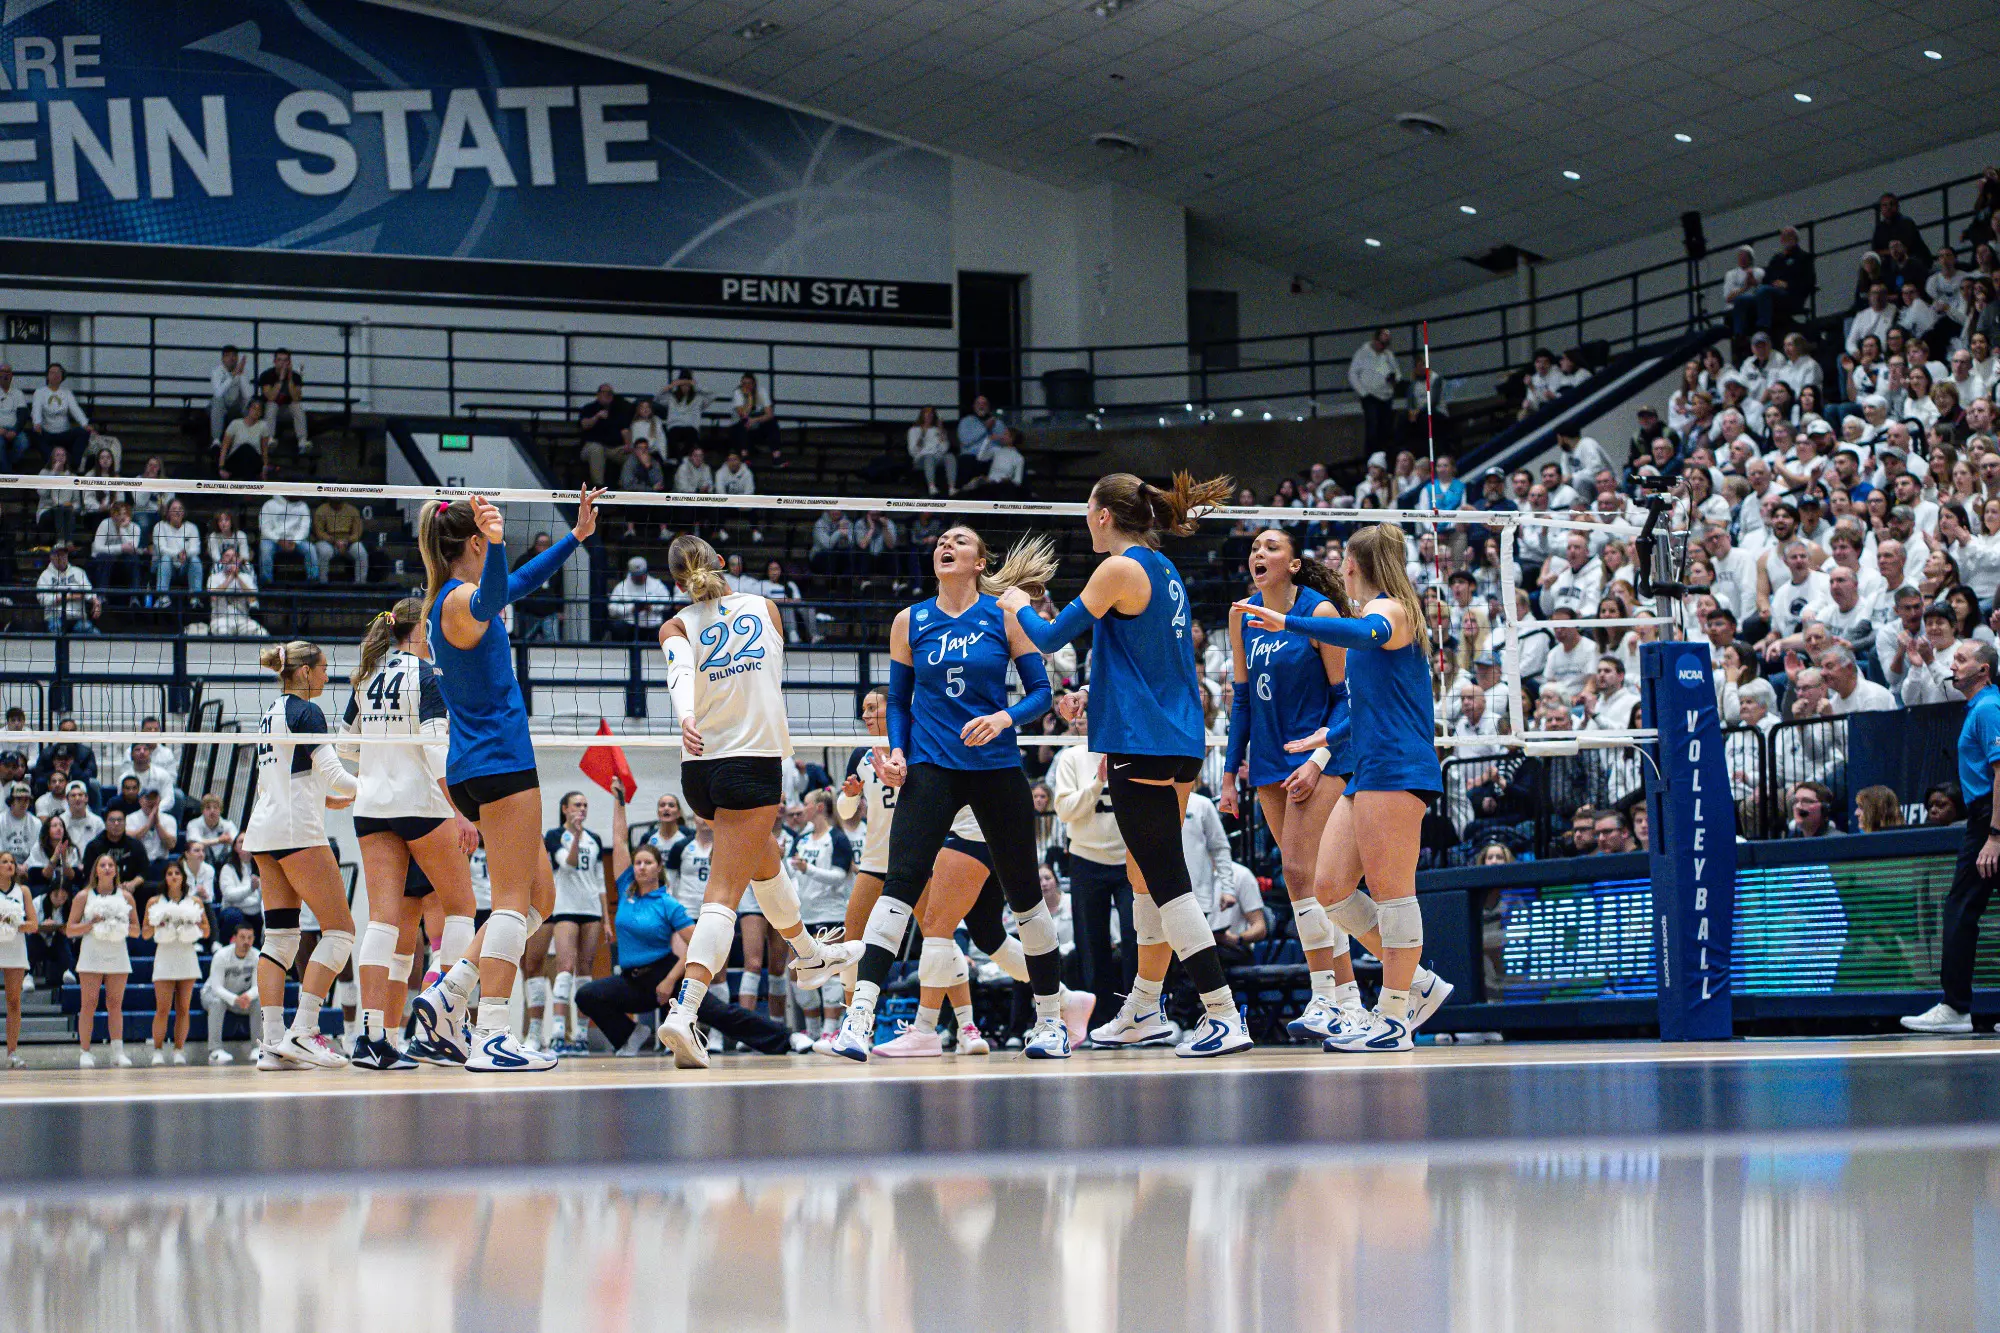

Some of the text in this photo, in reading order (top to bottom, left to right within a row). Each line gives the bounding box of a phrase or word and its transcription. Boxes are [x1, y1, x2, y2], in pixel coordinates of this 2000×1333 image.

[0, 35, 106, 90] RE
[275, 83, 659, 196] STATE
[721, 278, 899, 308] PENN STATE
[1168, 579, 1186, 627] 2
[700, 613, 765, 673] 22
[927, 630, 985, 665] Jays
[1247, 635, 1288, 669] Jays
[709, 661, 762, 682] BILINOVIC
[945, 666, 966, 697] 5
[1256, 673, 1272, 701] 6
[1678, 670, 1703, 680] NCAA
[366, 672, 405, 709] 44
[1686, 710, 1712, 1000] VOLLEYBALL
[698, 866, 708, 881] 6
[1661, 915, 1671, 988] sports imports
